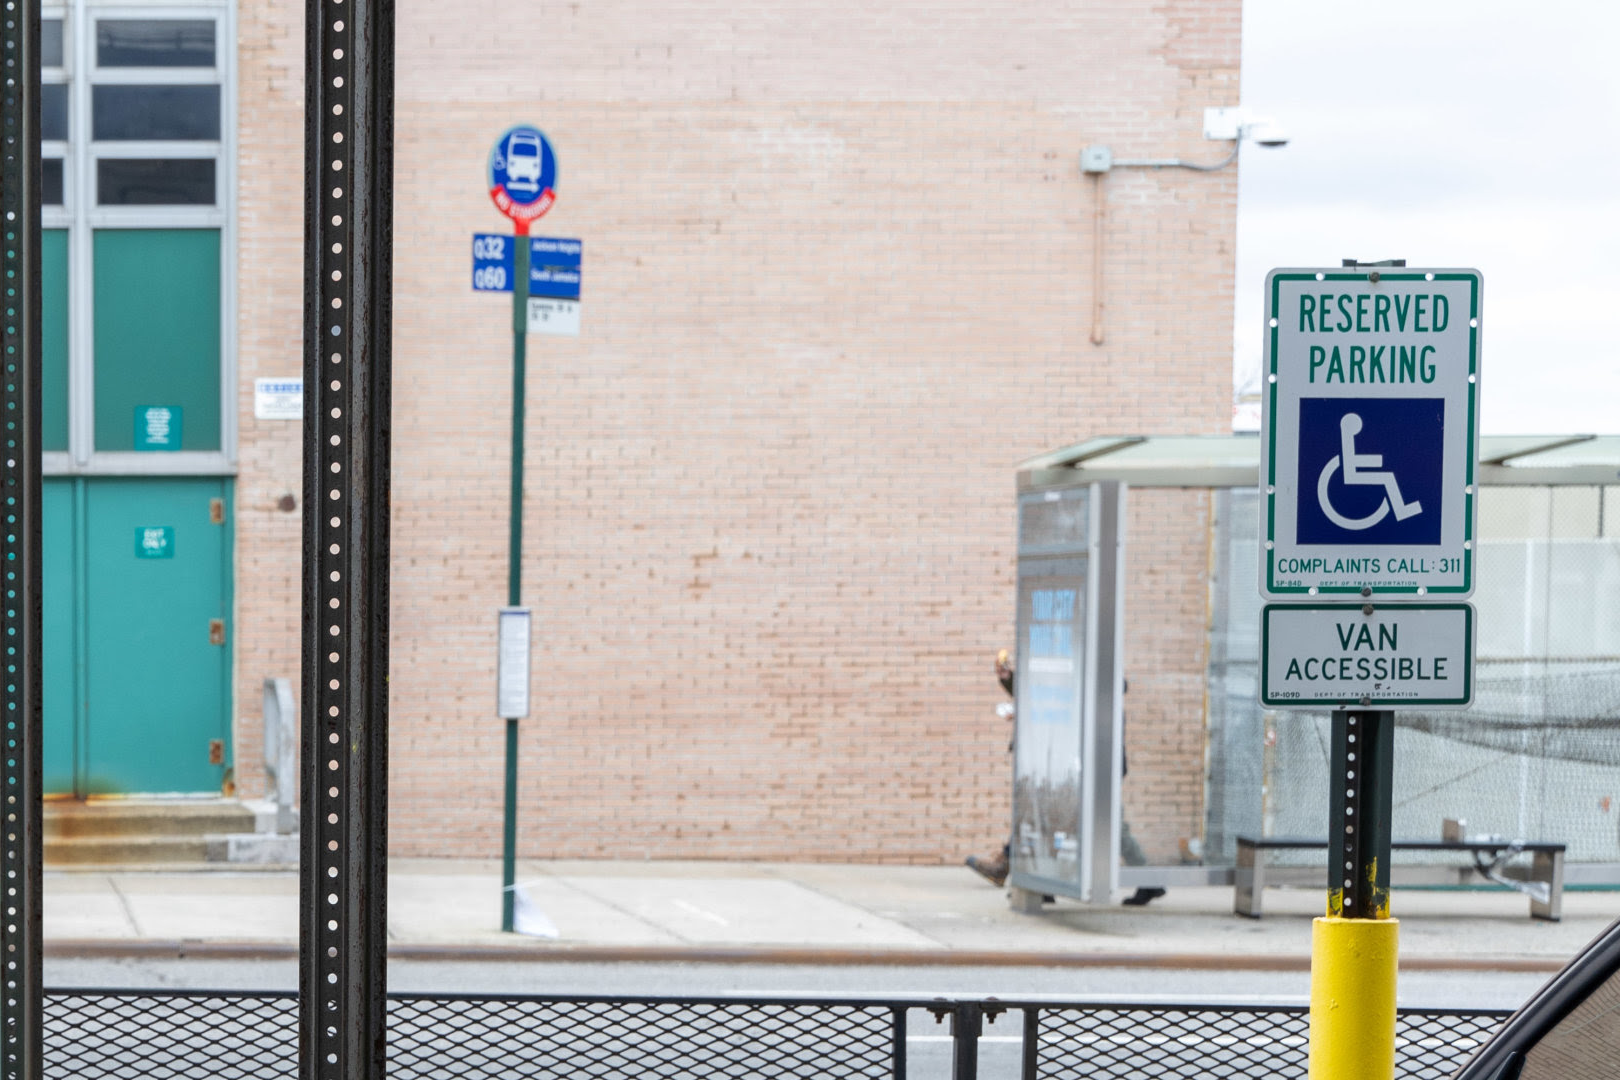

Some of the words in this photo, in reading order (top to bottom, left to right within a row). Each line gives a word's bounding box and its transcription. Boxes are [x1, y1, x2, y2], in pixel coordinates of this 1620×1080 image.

[473, 236, 505, 260] Q32
[474, 266, 506, 290] Q60
[1299, 294, 1450, 333] RESERVED
[1309, 345, 1437, 384] PARKING
[1278, 558, 1381, 573] COMPLAINTS
[1439, 558, 1461, 573] 311
[1336, 623, 1398, 651] VAN
[1285, 657, 1448, 681] ACCESSIBLE
